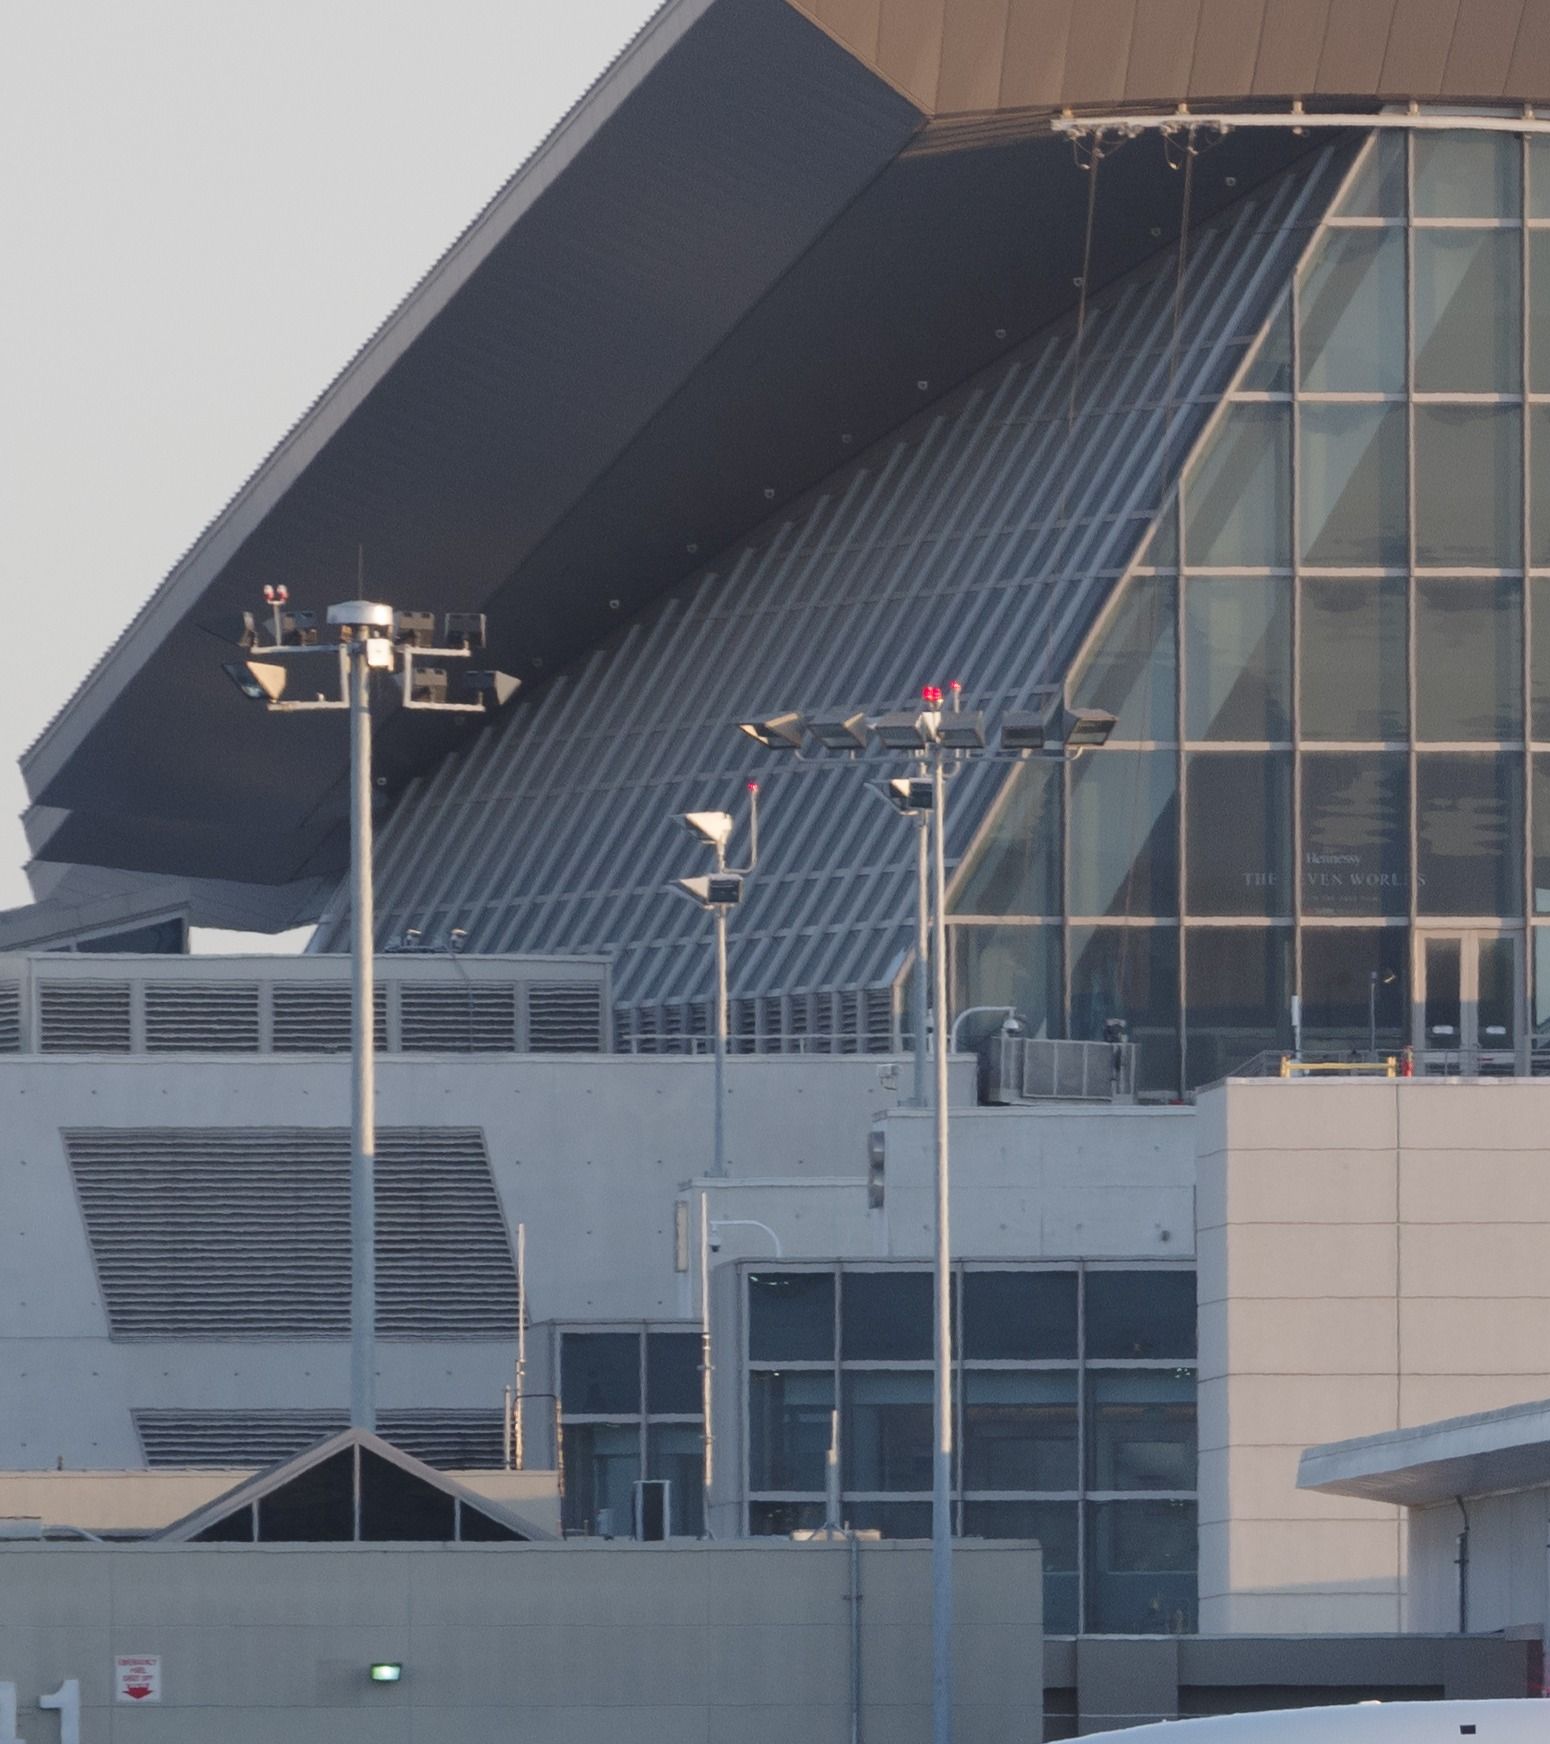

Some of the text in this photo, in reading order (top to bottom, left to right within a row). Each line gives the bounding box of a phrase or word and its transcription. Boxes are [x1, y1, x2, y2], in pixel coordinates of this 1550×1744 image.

[1306, 852, 1361, 866] Hennessy
[1242, 872, 1278, 886] THE
[1350, 871, 1426, 887] WORLS
